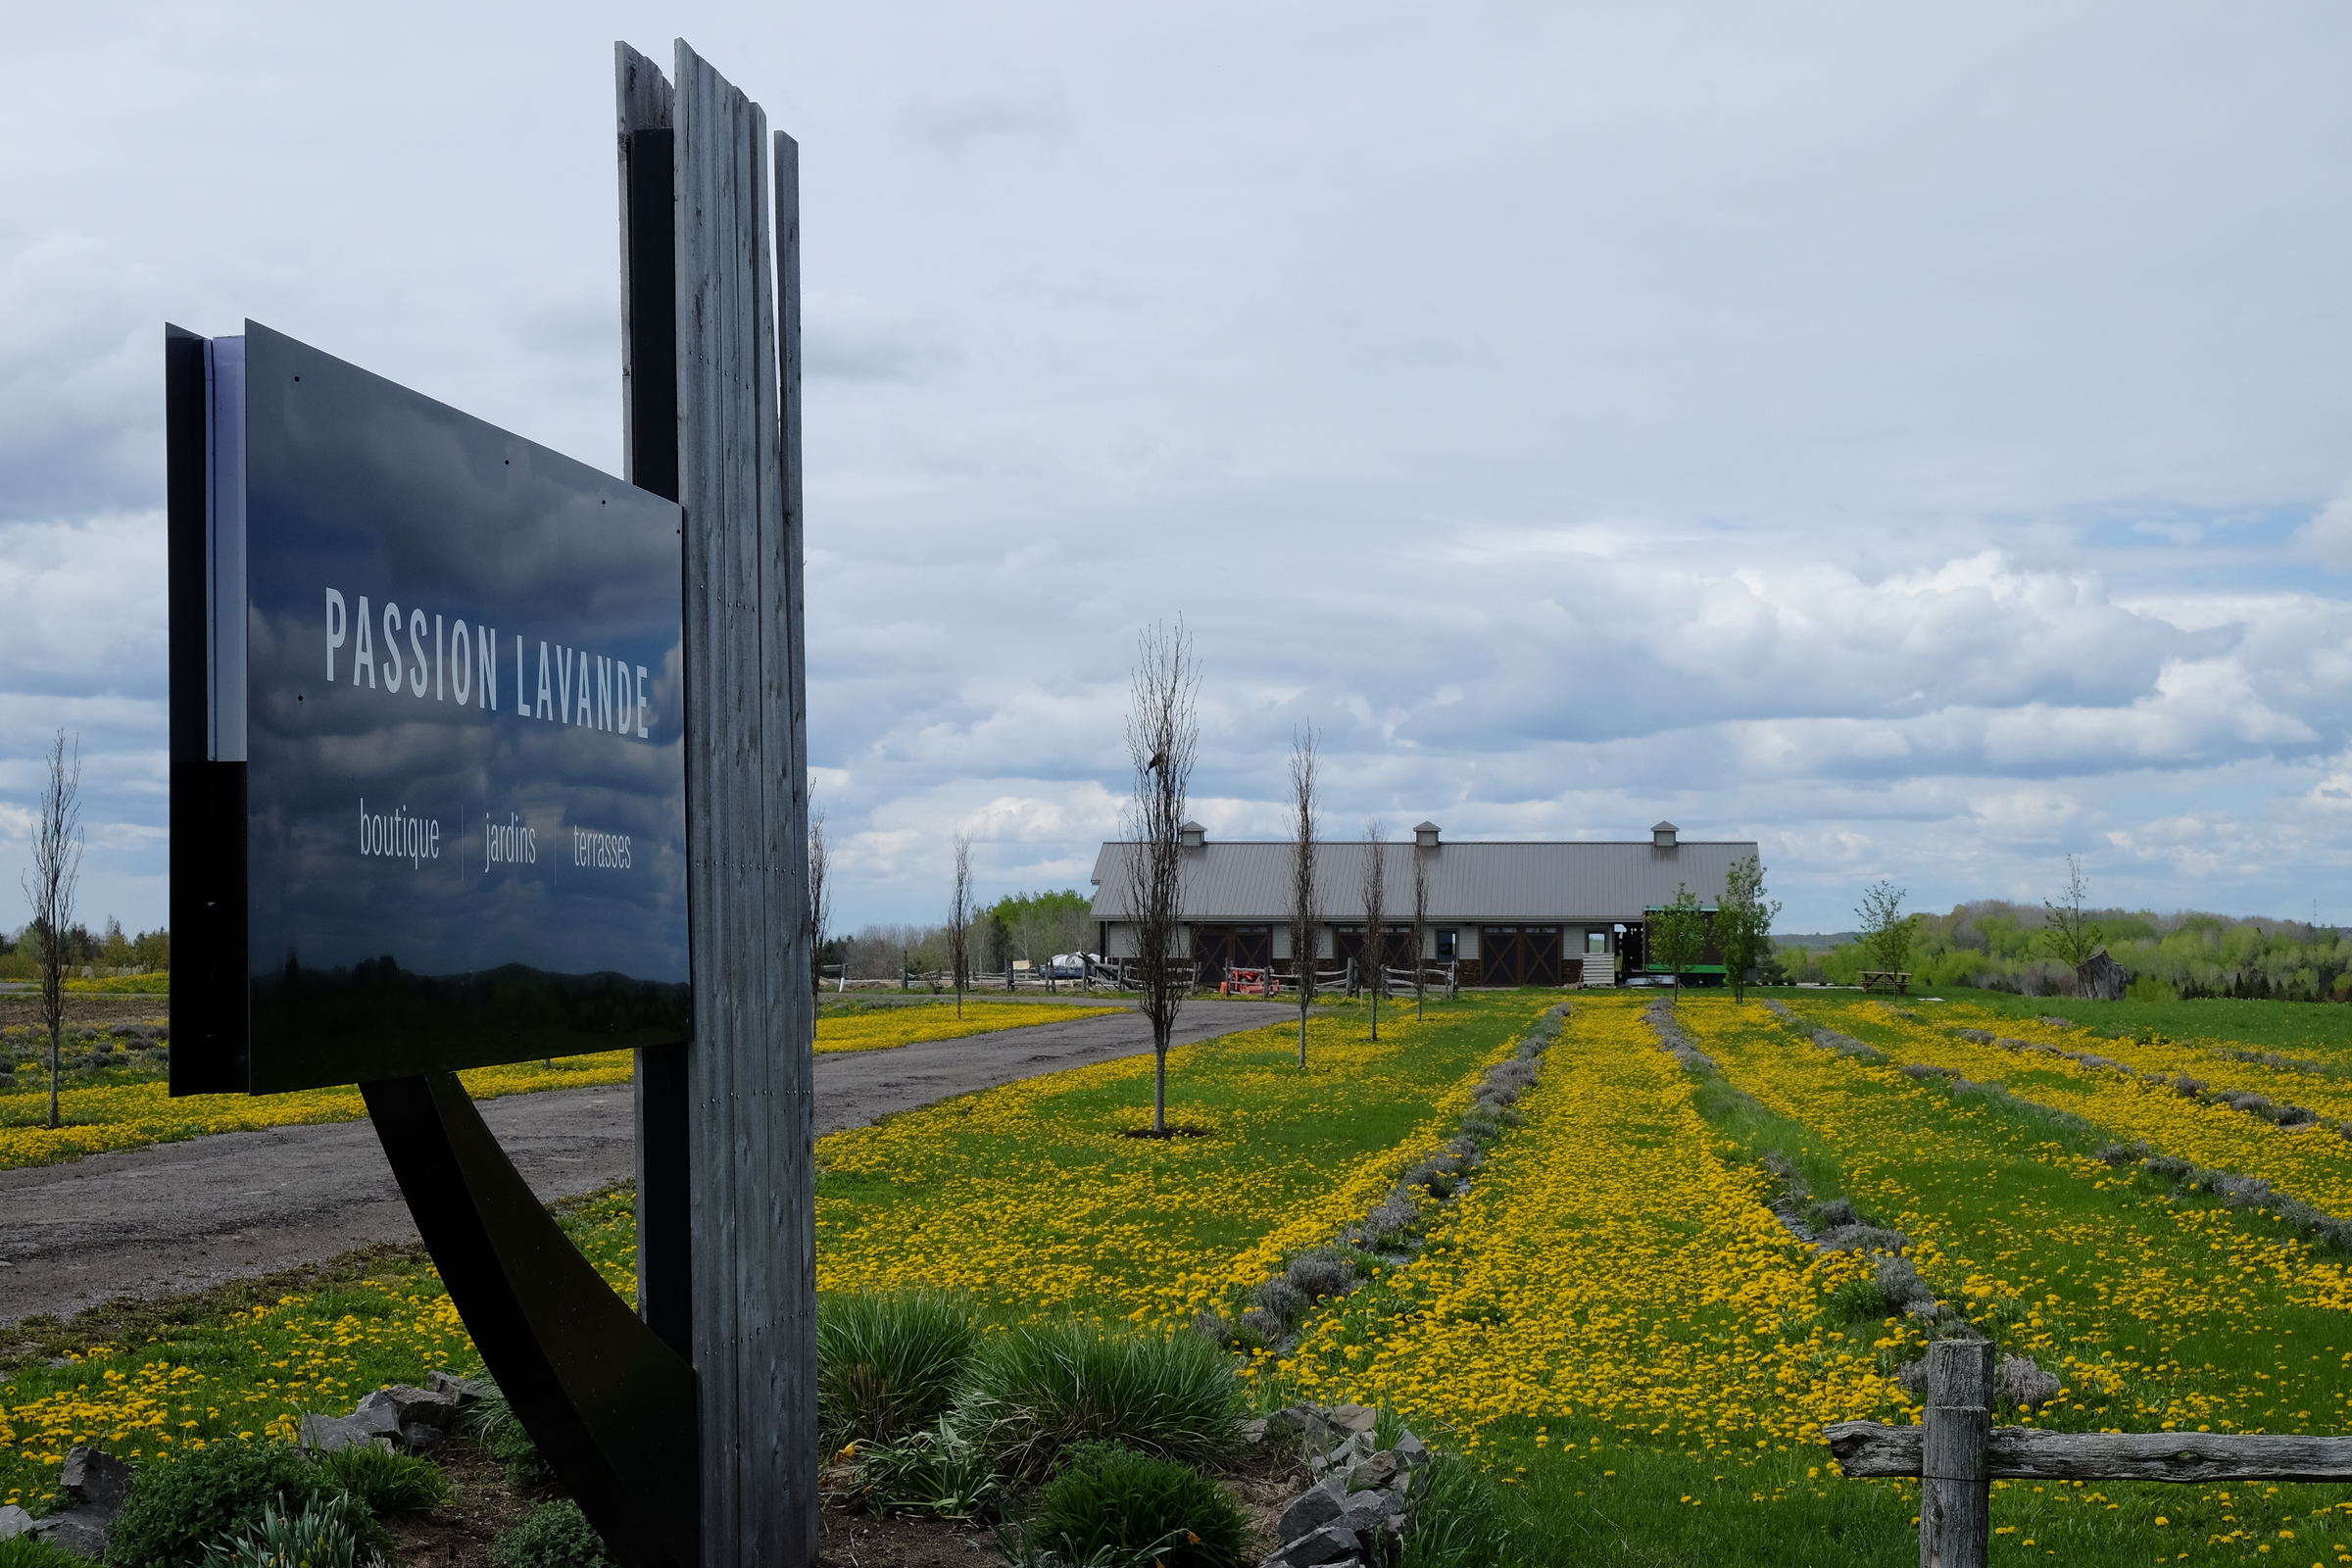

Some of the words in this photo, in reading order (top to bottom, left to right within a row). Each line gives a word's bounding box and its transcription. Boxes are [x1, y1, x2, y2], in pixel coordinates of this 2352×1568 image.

[326, 588, 497, 710] PASSION
[516, 635, 649, 738] LAVANDE
[361, 798, 439, 869] boutique
[485, 812, 536, 873] jardins
[574, 824, 631, 869] terrasses
